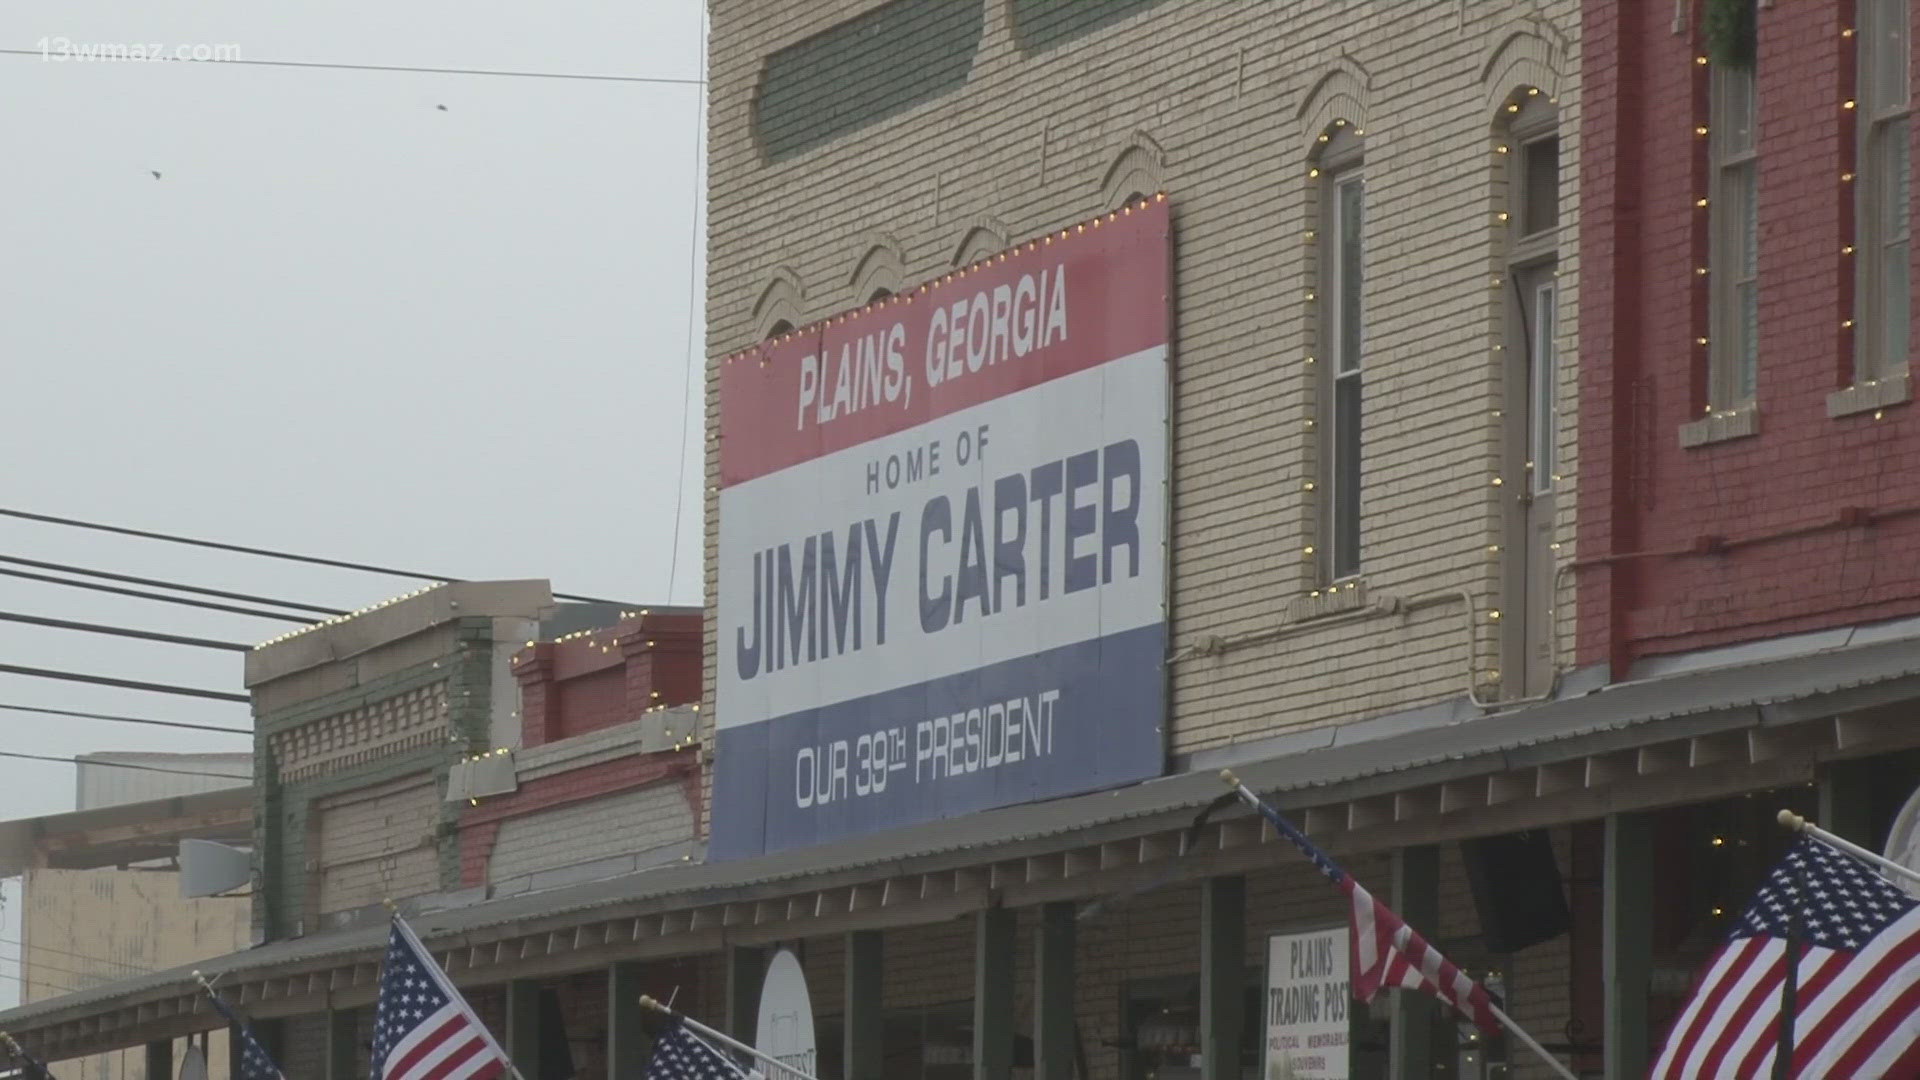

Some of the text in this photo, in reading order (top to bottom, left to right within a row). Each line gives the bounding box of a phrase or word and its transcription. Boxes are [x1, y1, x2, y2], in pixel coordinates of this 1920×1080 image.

[797, 264, 1068, 430] PLAINS, GEORGIA
[866, 425, 990, 495] HOME OF
[736, 438, 1141, 681] JIMMY CARTER
[796, 689, 1060, 809] OUR 39TH PRESIDENT
[1270, 984, 1320, 1026] TRADING
[1290, 937, 1334, 980] PLAINS
